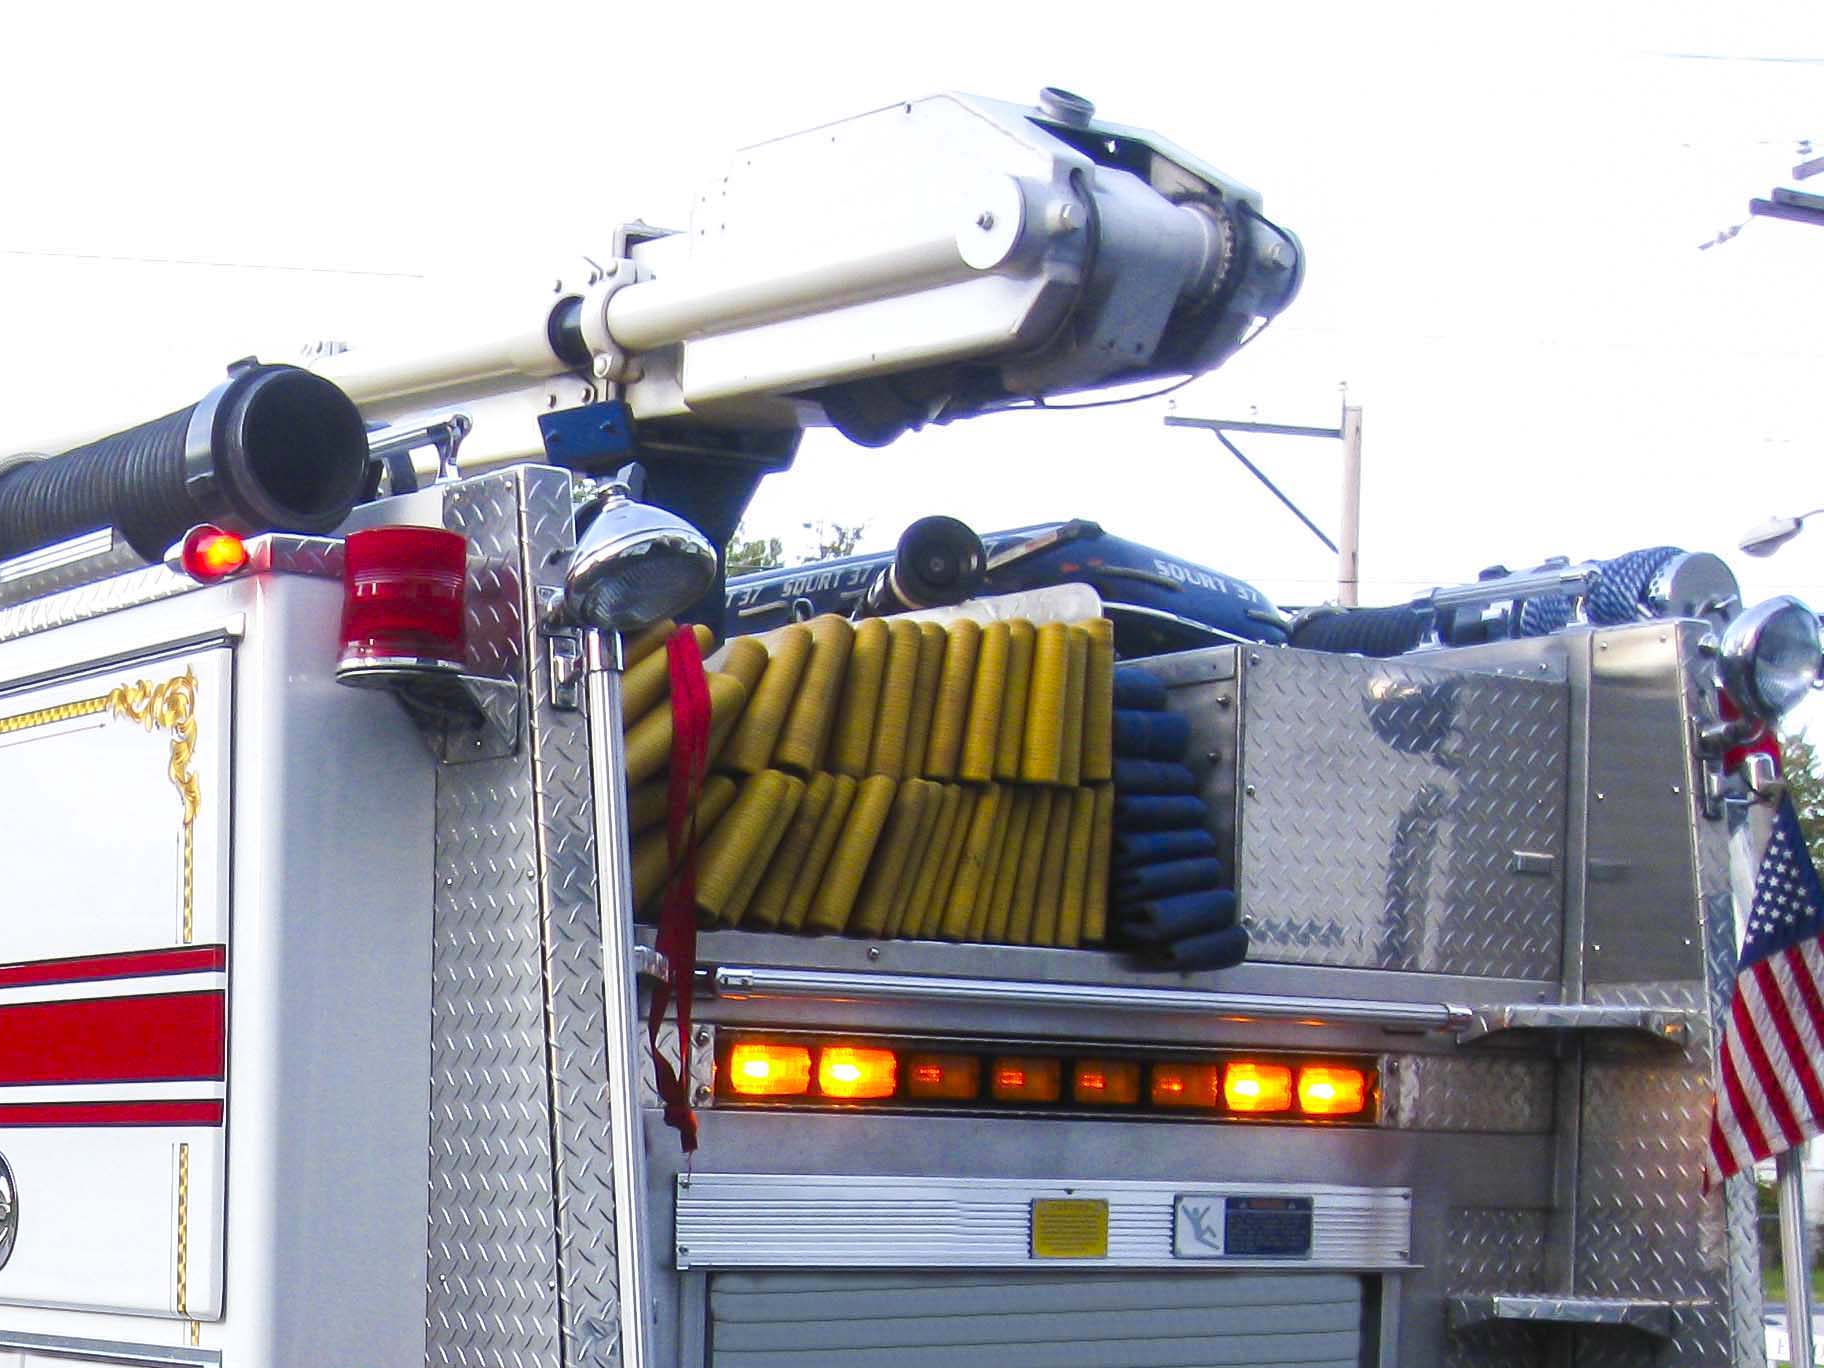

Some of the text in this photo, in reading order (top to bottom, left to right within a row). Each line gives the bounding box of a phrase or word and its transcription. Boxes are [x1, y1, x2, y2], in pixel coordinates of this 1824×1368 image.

[737, 584, 763, 606] 37
[780, 569, 842, 598] SQURT
[847, 565, 875, 587] 37
[1153, 558, 1259, 603] SQURT 37
